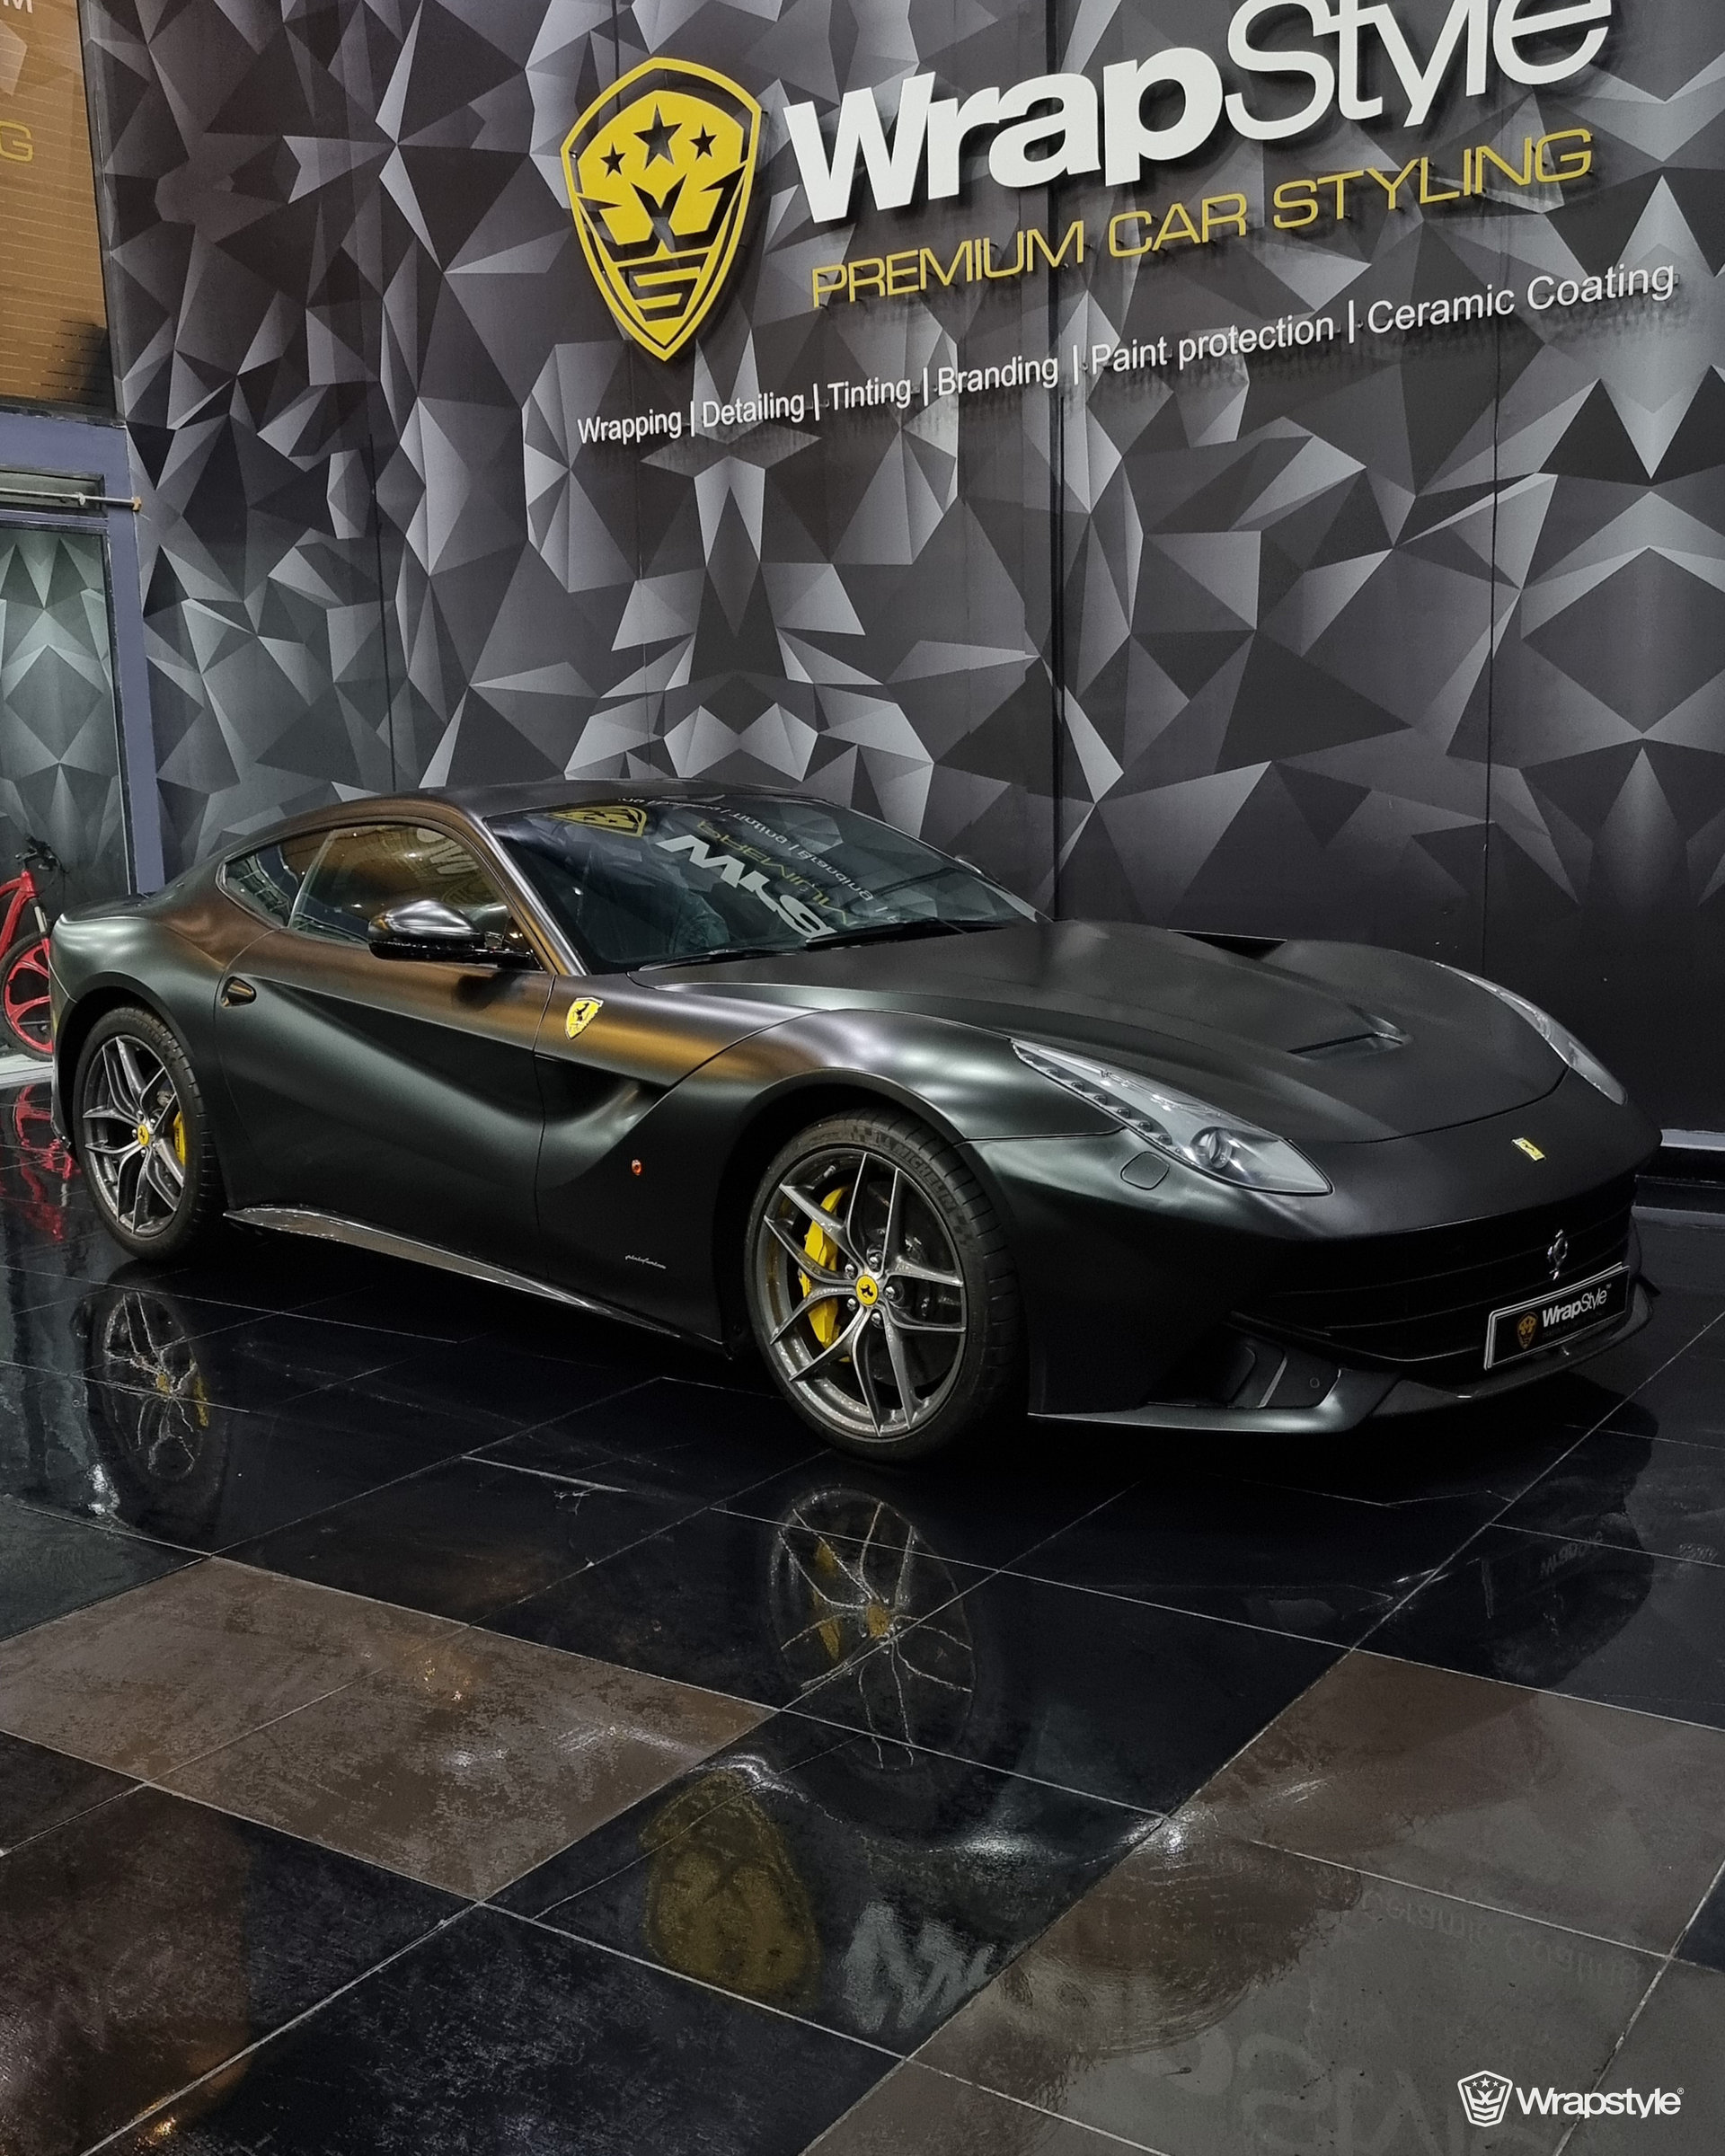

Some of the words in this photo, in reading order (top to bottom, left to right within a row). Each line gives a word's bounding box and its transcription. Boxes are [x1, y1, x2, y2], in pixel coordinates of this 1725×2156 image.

[783, 0, 1612, 224] WrapStyle
[811, 220, 1084, 308] PREMIUM
[1108, 192, 1248, 259] CAR
[1273, 128, 1593, 229] STYLING
[577, 408, 683, 445] Wrapping
[703, 392, 805, 428] Detailing
[827, 377, 912, 411] Tinting
[937, 355, 1058, 396] Branding
[1091, 336, 1168, 376] Paint
[1178, 315, 1335, 370] protection
[1367, 284, 1515, 334] Ceramic
[1527, 263, 1676, 311] Coating
